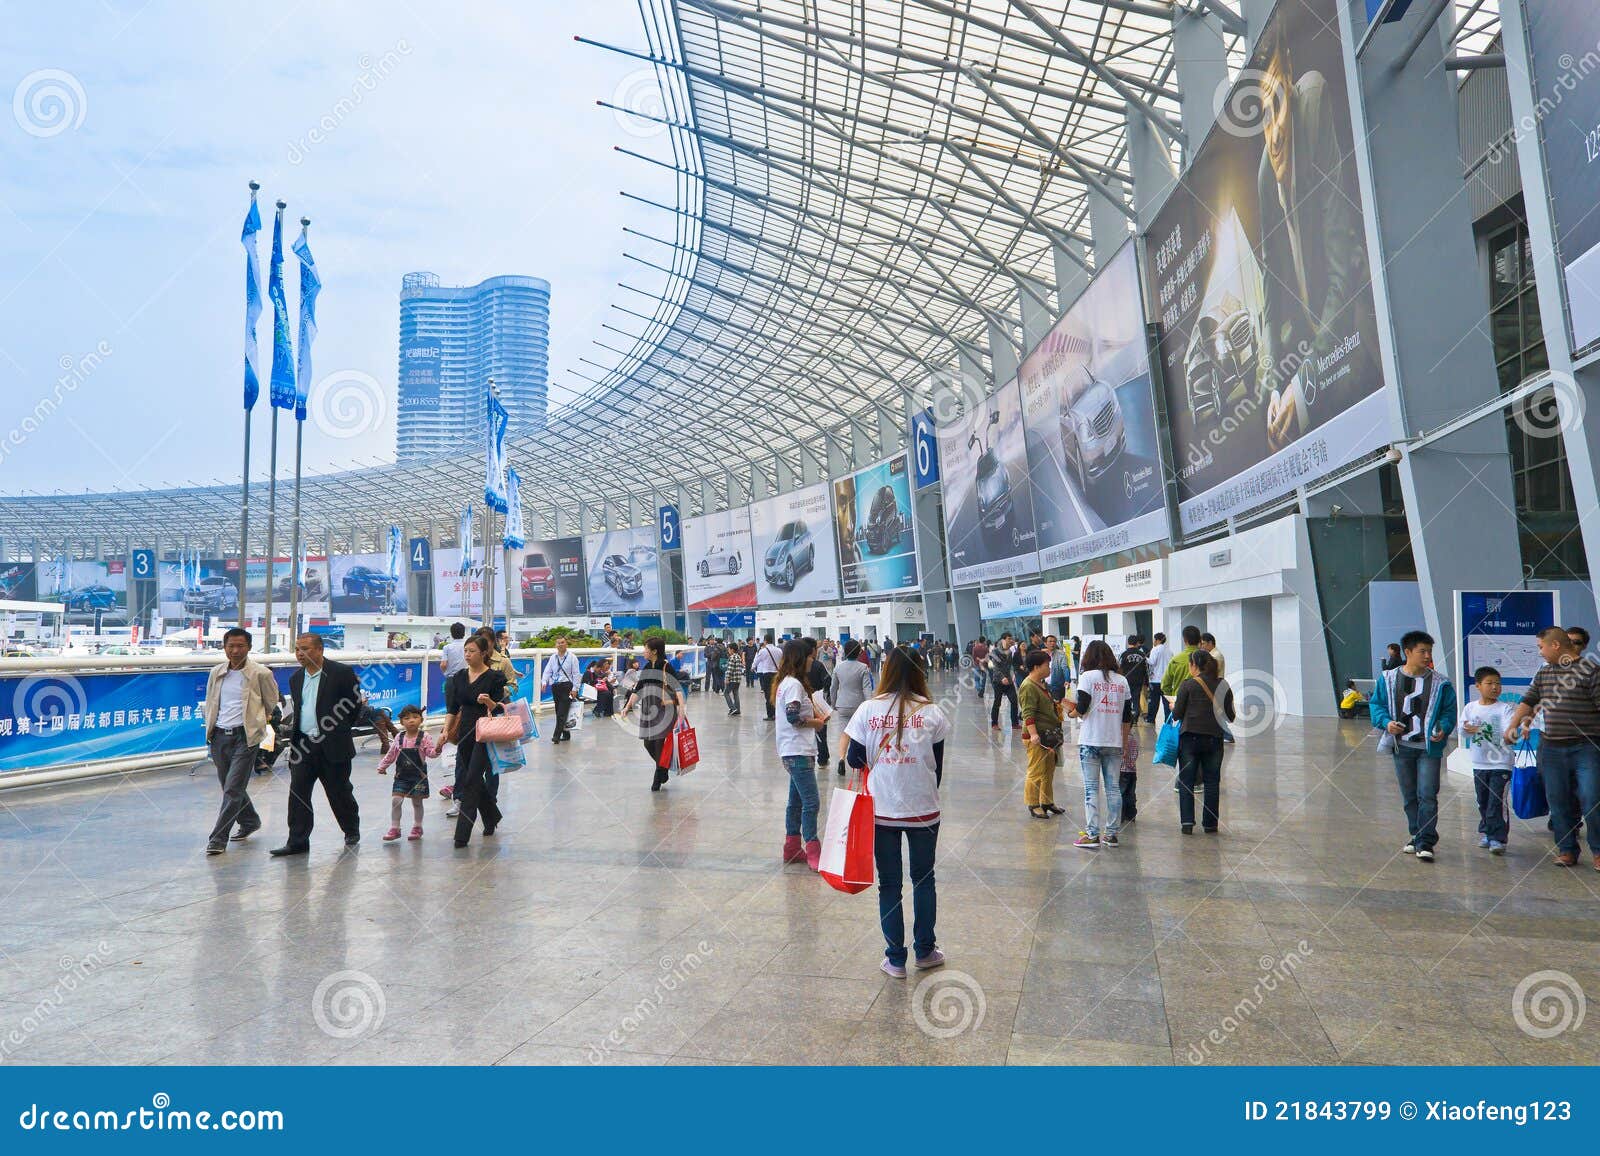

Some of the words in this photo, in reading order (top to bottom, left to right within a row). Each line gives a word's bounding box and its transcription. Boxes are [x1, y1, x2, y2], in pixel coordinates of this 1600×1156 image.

[917, 421, 930, 476] 6
[663, 511, 673, 543] 5
[136, 553, 149, 575] 3
[413, 542, 425, 566] 4
[382, 688, 397, 699] 2011
